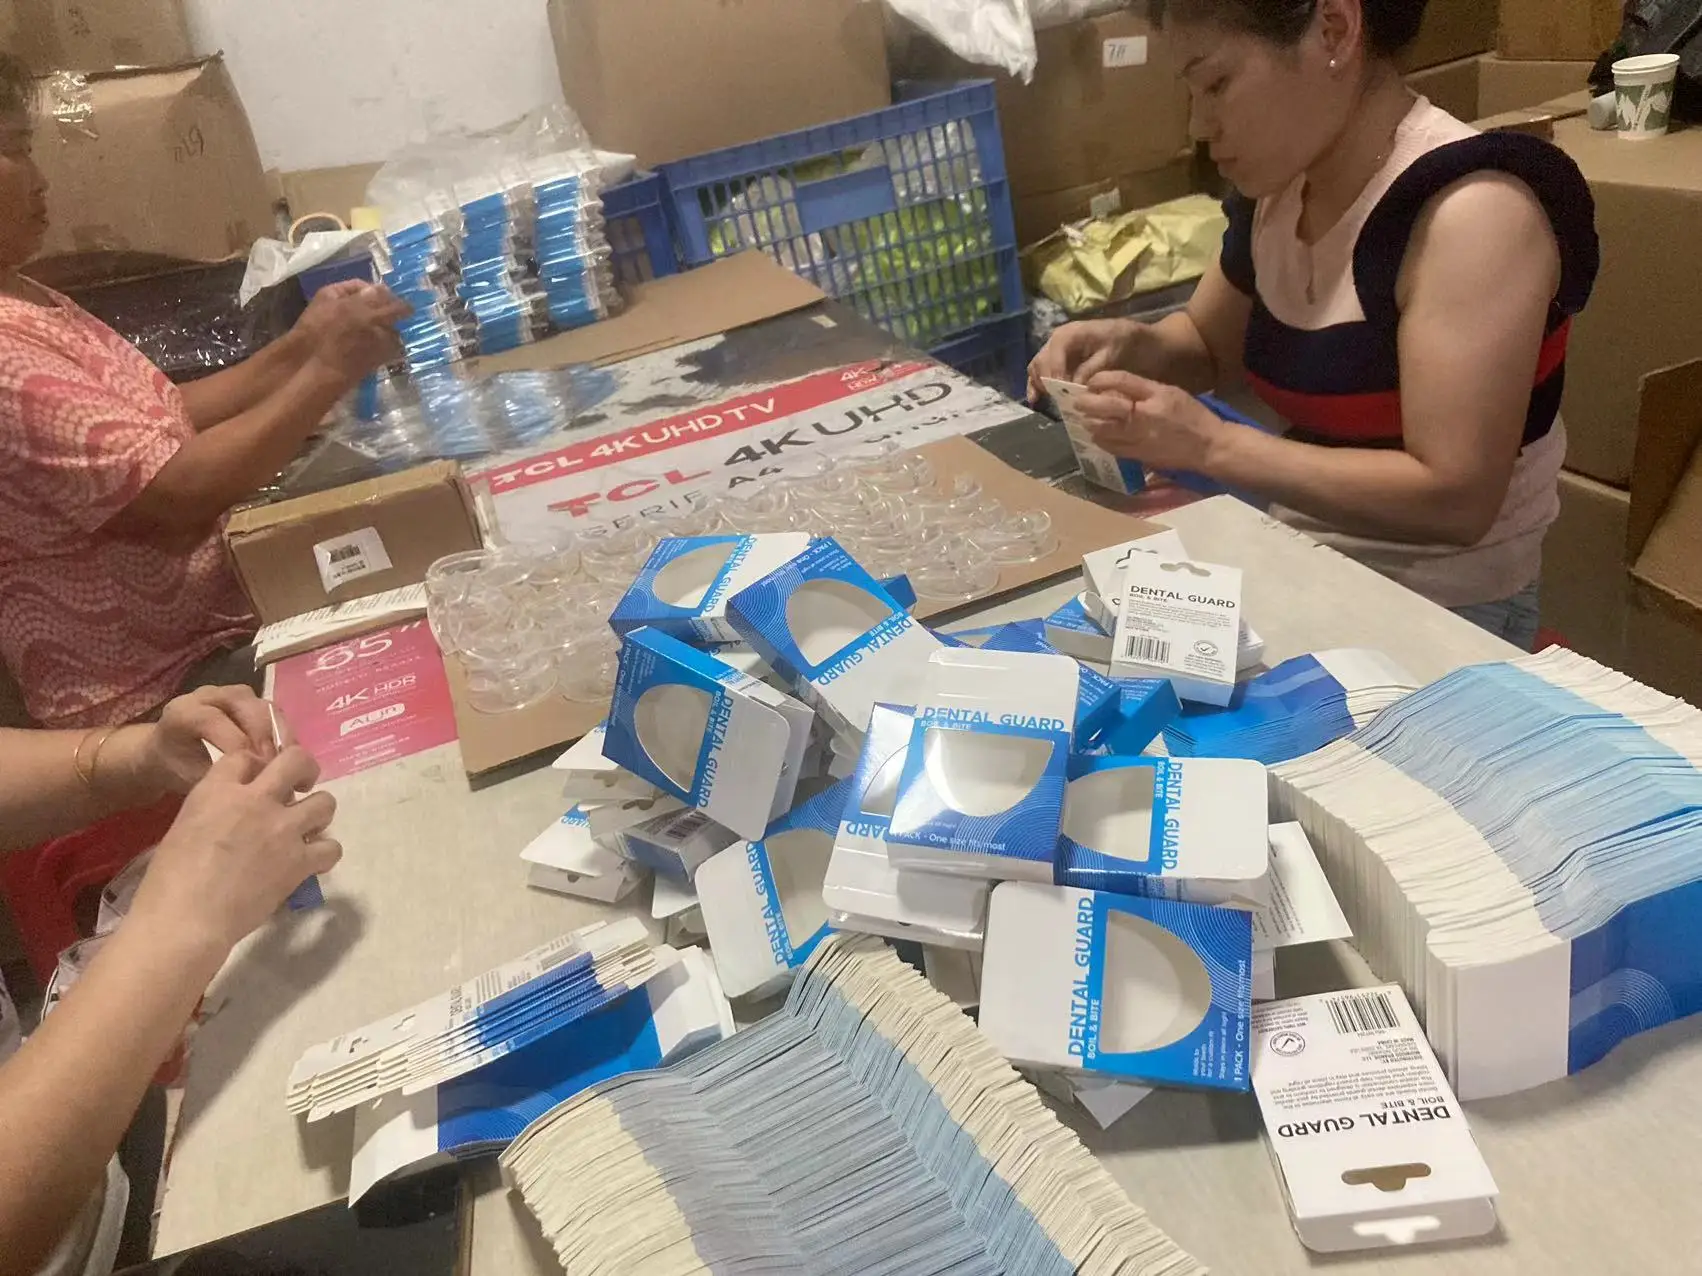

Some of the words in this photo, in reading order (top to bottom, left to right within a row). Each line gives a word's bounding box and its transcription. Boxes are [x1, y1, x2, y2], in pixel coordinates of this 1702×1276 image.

[492, 455, 583, 487] TCL
[590, 435, 641, 457] 4K
[548, 469, 711, 518] TCL
[725, 430, 812, 466] 4K
[729, 466, 784, 489] A4
[704, 576, 732, 613] GUARD
[1130, 585, 1183, 600] DENTAL
[1188, 594, 1236, 609] GUARD
[867, 618, 913, 653] DENTAL
[817, 652, 863, 686] GUARD
[326, 687, 369, 711] 4K
[374, 675, 417, 694] HDR
[712, 696, 734, 751] DENTAL
[923, 706, 993, 723] DENTAL
[1000, 713, 1065, 731] GUARD
[697, 758, 718, 808] GUARD
[1165, 762, 1183, 810] DENTAL
[929, 833, 948, 844] One
[950, 836, 967, 846] size
[984, 841, 1006, 850] most
[1161, 818, 1180, 870] GUARD
[745, 842, 767, 896] GUARD
[761, 903, 785, 965] DENTAL
[1074, 897, 1094, 967] GUARD
[1238, 959, 1246, 981] most
[1067, 974, 1089, 1056] DENTAL
[1090, 999, 1100, 1021] BITE
[1087, 1036, 1097, 1059] BOIL
[1236, 1021, 1244, 1041] One
[1234, 1050, 1244, 1075] PACK
[1359, 1105, 1451, 1127] DENTAL
[1382, 1100, 1405, 1109] BITE
[1418, 1095, 1445, 1105] BOIL
[1278, 1116, 1355, 1138] GUARD
